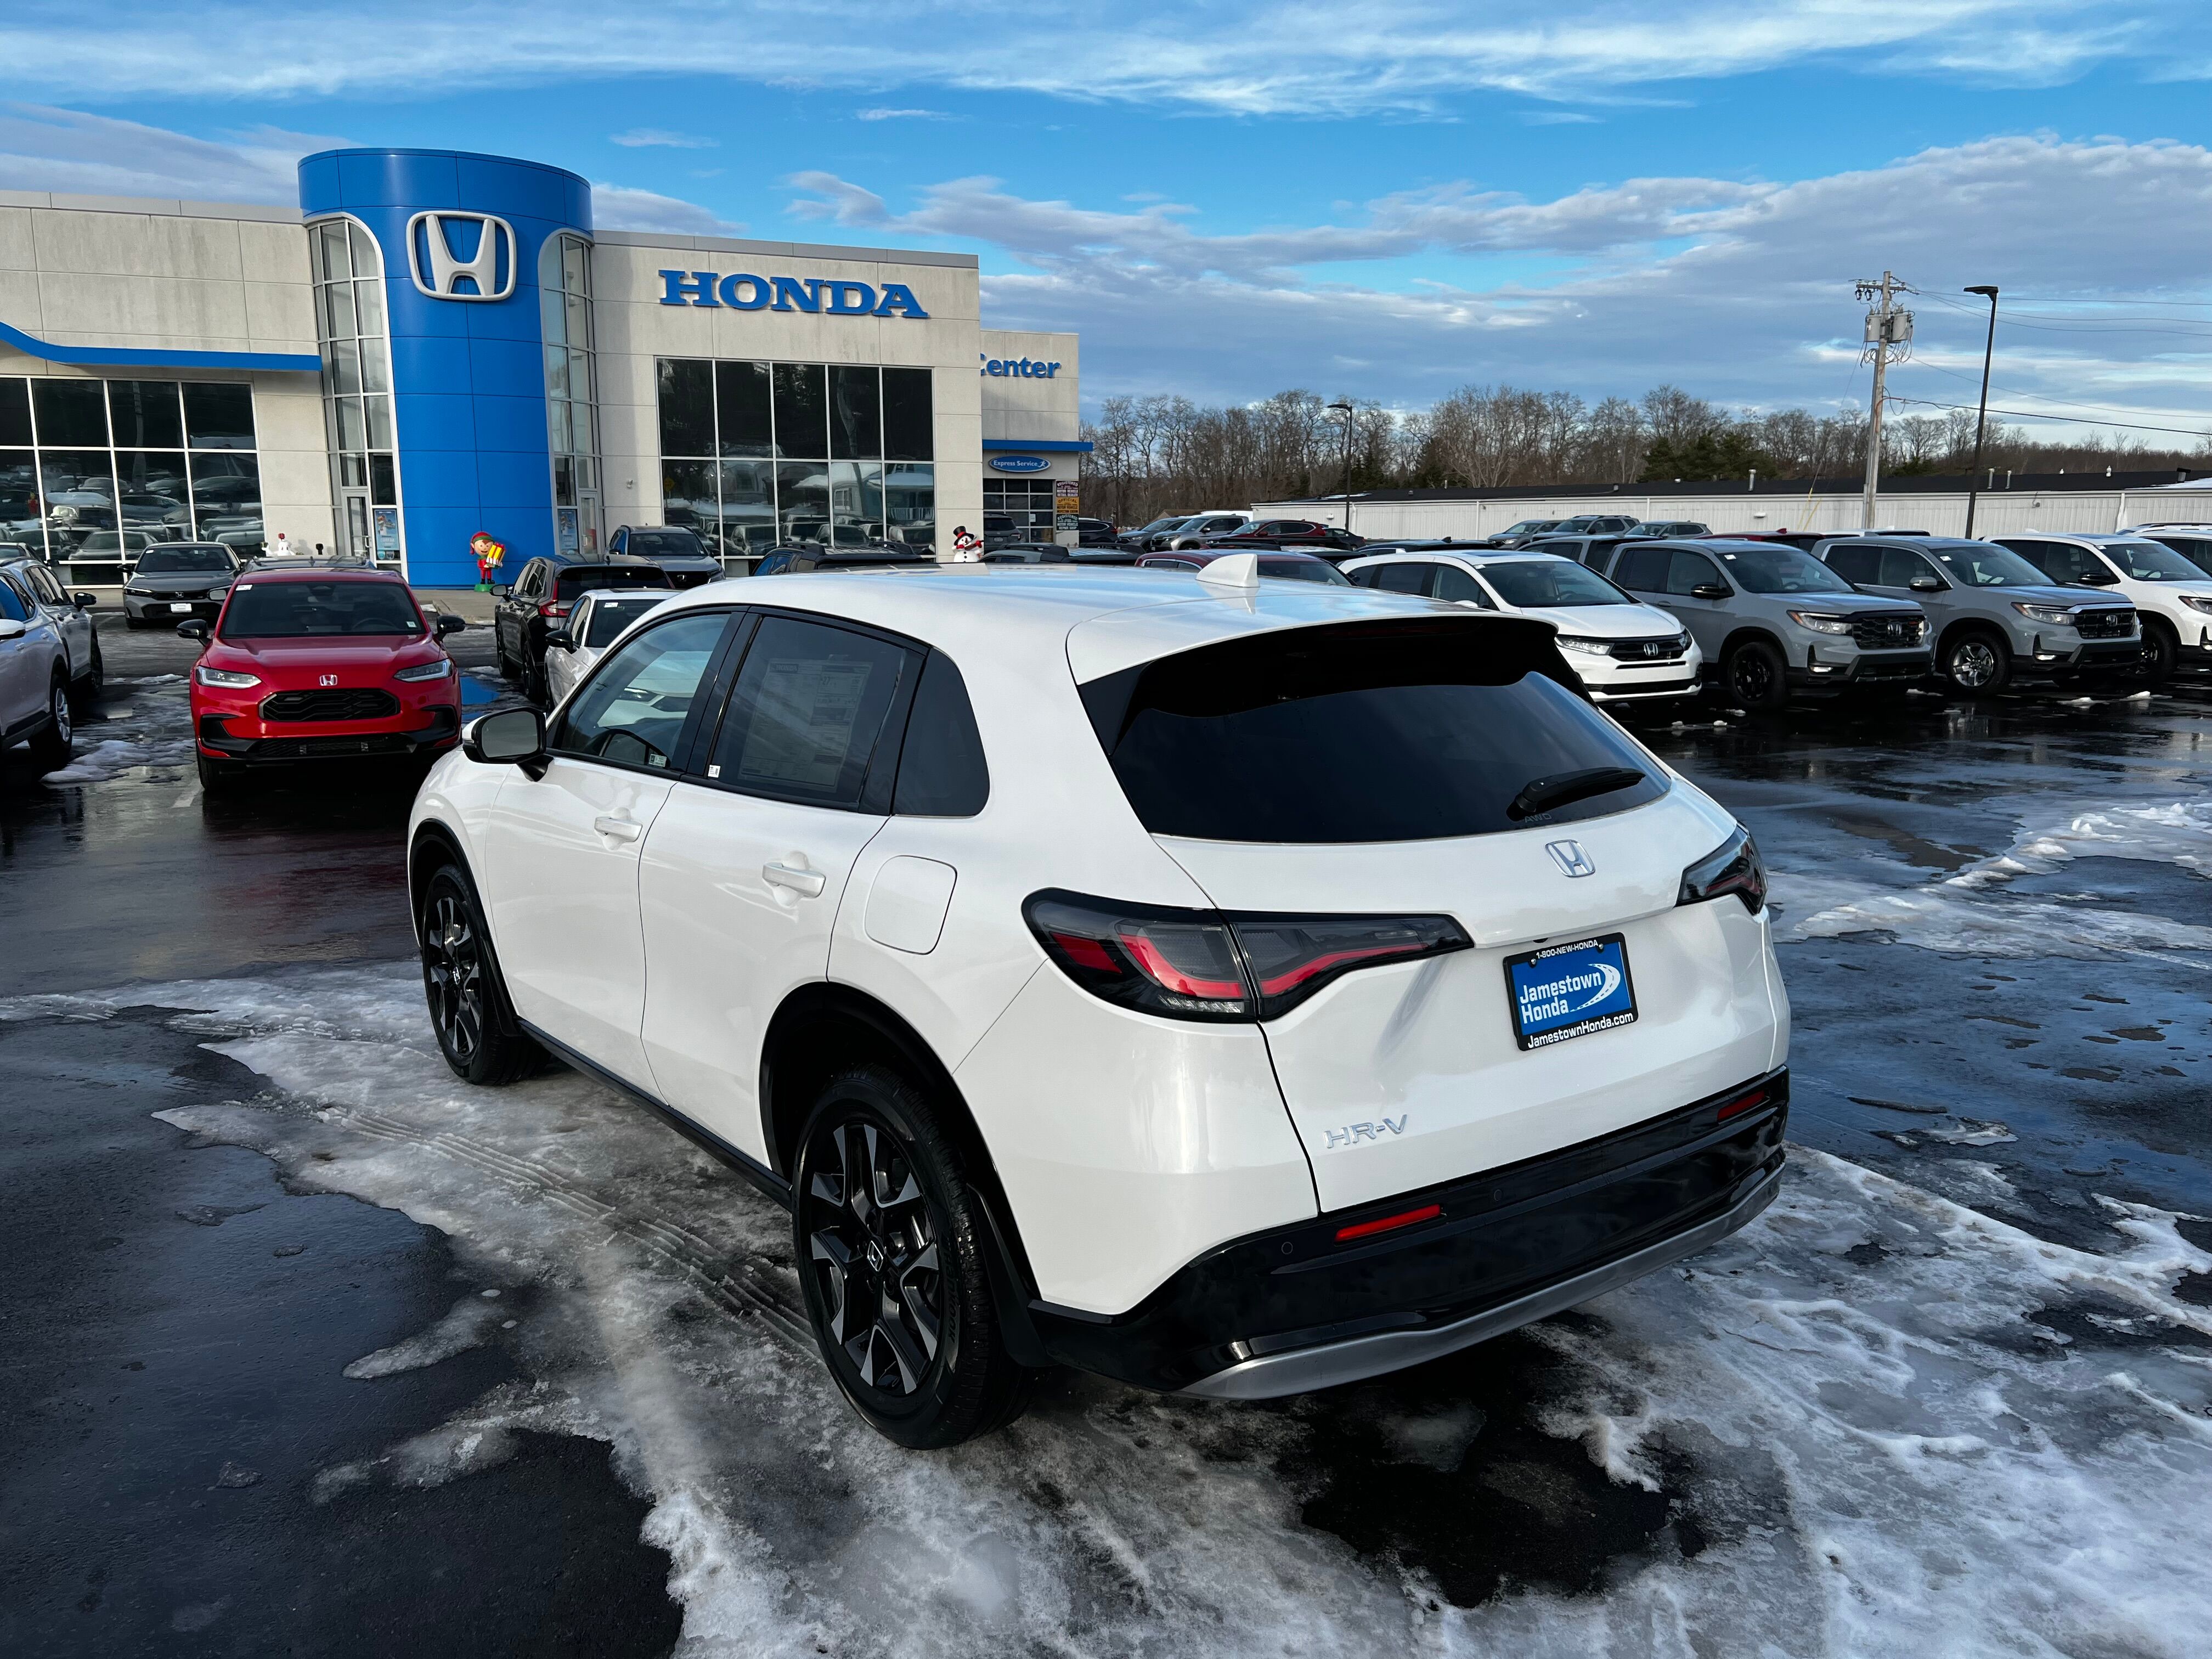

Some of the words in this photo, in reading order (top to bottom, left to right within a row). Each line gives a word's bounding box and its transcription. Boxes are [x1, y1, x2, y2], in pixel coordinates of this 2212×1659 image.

[658, 269, 929, 318] HONDA
[980, 353, 1061, 379] enter
[1525, 813, 1552, 823] AWD
[1536, 939, 1599, 959] 1-800-NEW-HONDA
[1520, 972, 1602, 1005] Jamestown
[1521, 996, 1569, 1024] Honda
[1527, 1012, 1634, 1049] JamestownHonda.com
[1323, 1114, 1407, 1149] HR-V
